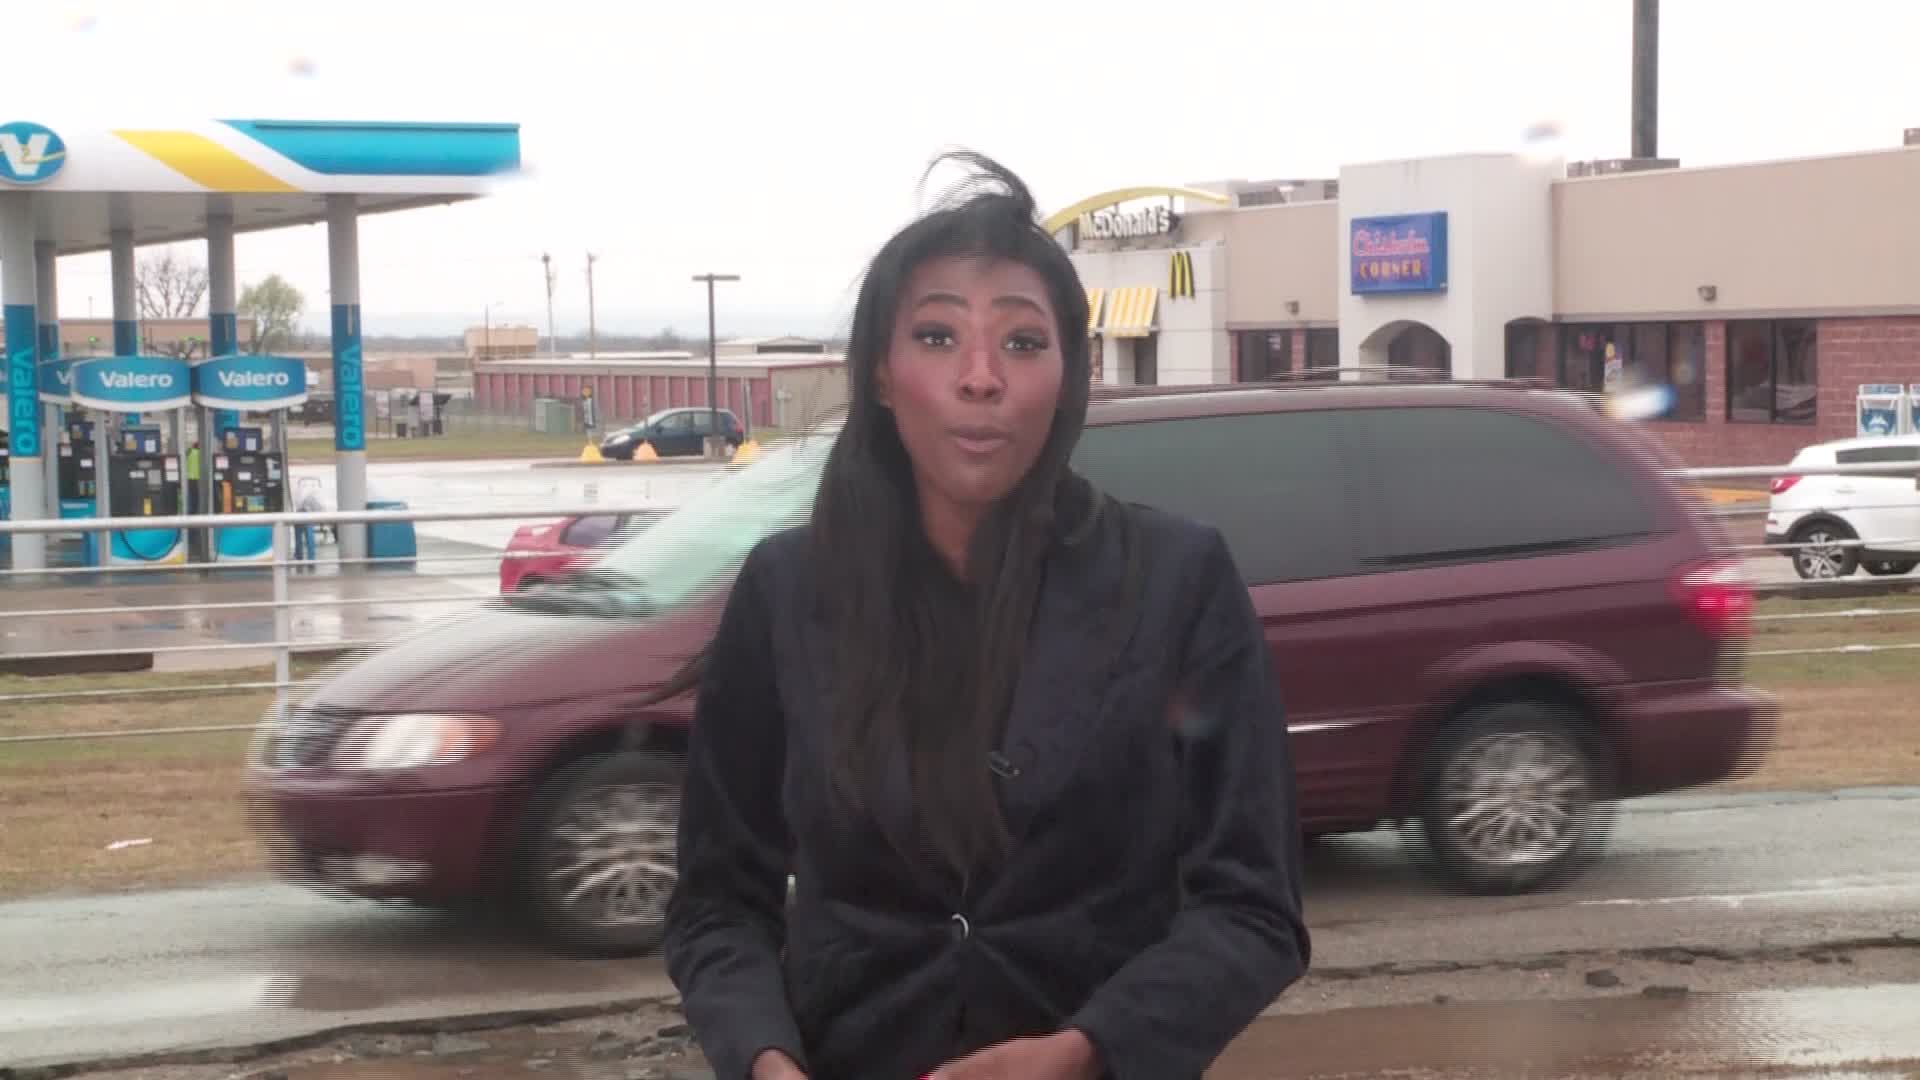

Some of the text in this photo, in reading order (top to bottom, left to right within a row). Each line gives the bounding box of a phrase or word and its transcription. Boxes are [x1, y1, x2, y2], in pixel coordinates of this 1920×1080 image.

[1080, 205, 1170, 239] McDonald's
[99, 370, 174, 389] Valero
[217, 370, 289, 388] Valero
[10, 345, 36, 455] Valero
[340, 344, 361, 449] Valero
